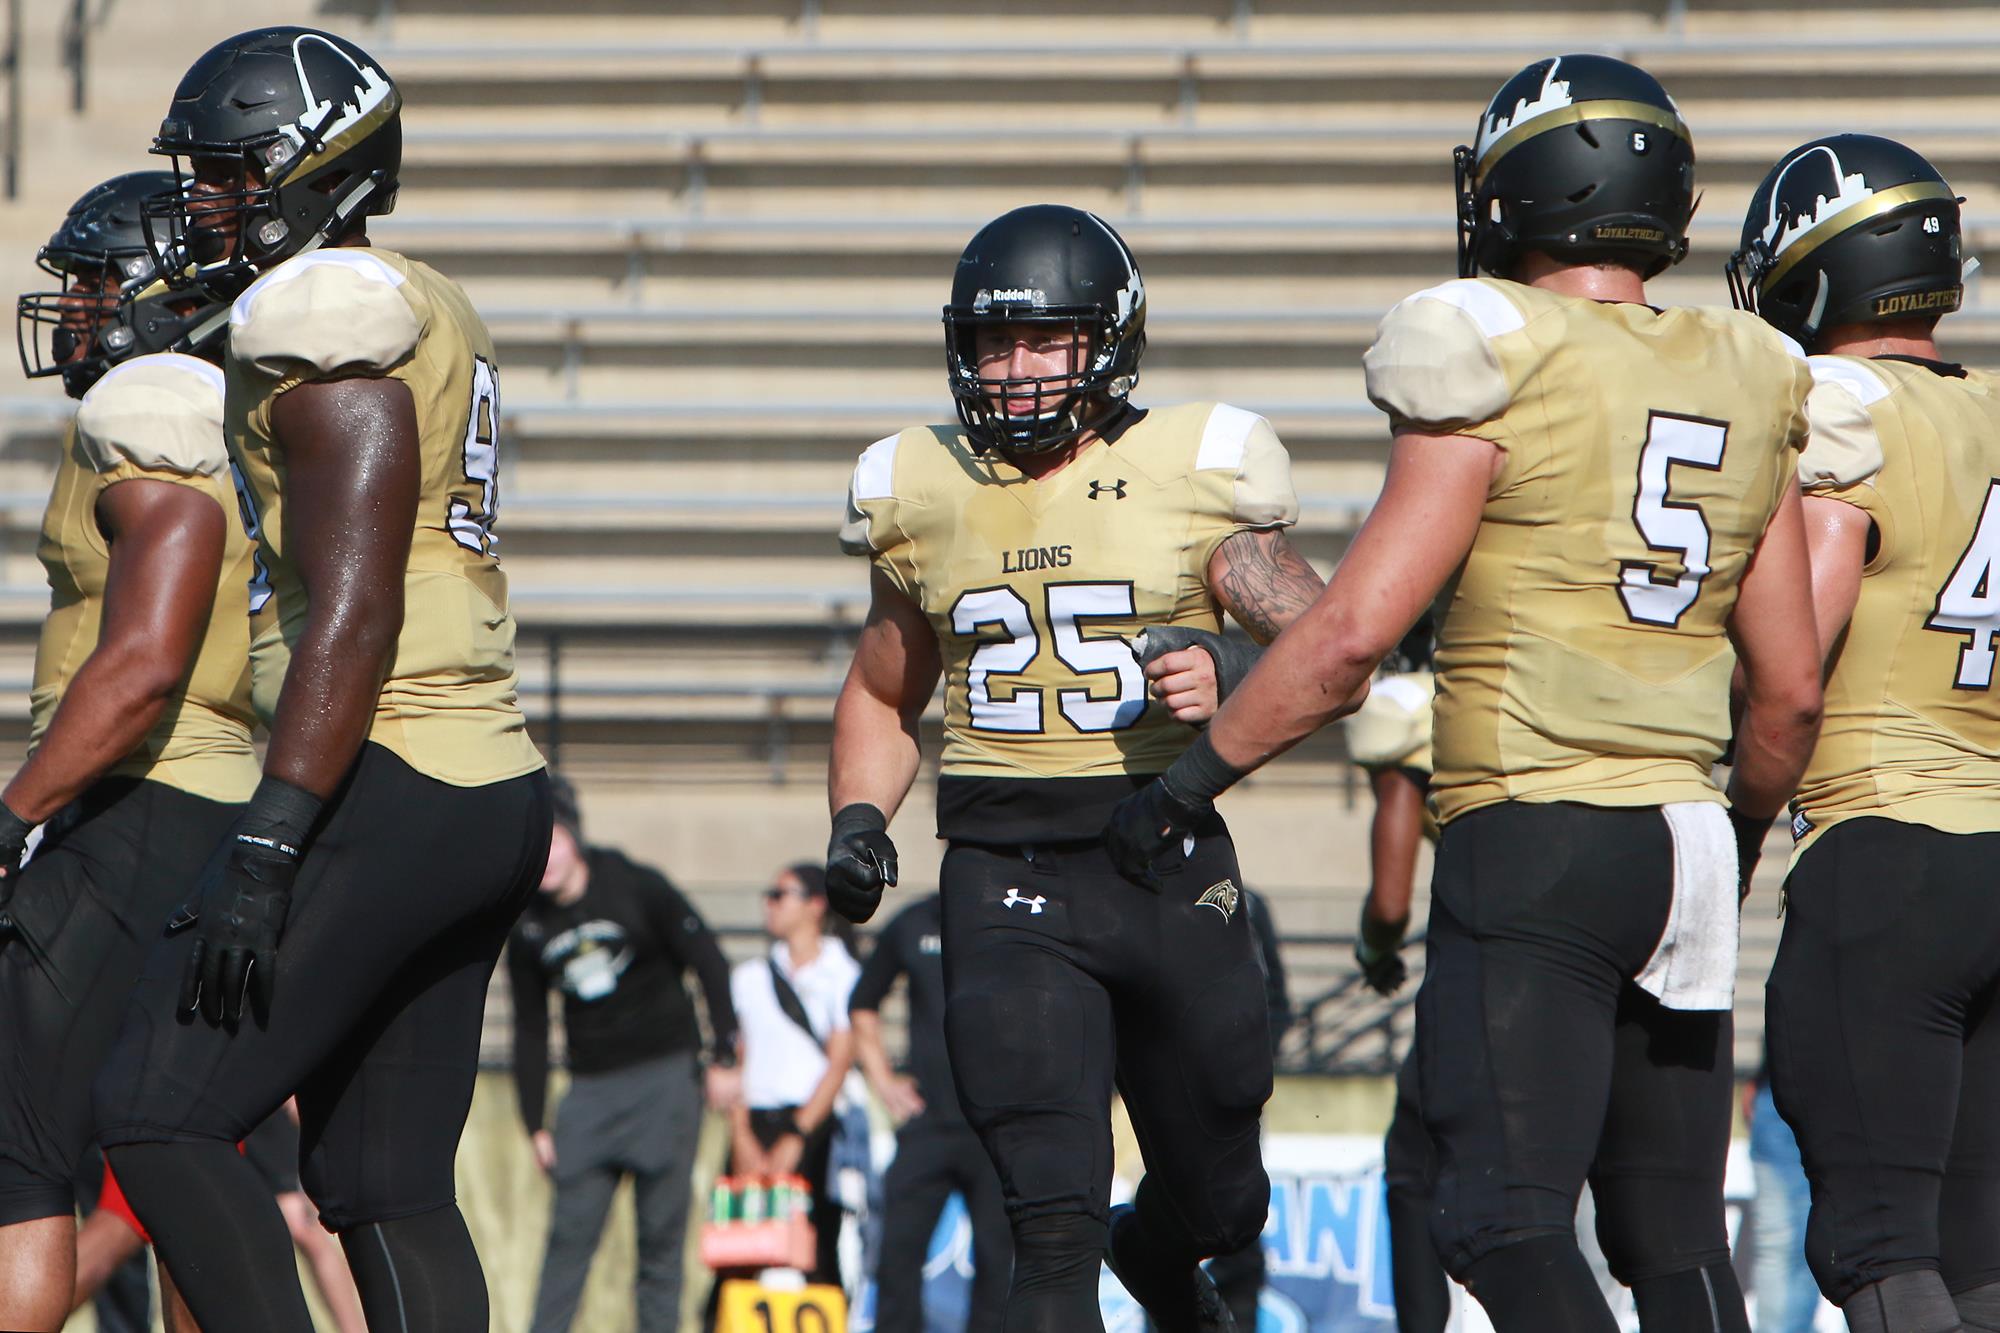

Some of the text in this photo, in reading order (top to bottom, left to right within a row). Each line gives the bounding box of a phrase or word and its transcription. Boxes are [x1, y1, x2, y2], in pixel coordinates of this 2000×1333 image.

[1633, 132, 1646, 151] 5
[1922, 216, 1940, 234] 49
[992, 288, 1032, 301] Riddell
[1614, 408, 1731, 630] 5
[1001, 544, 1072, 574] LIONS
[1921, 477, 2000, 691] 4
[947, 579, 1149, 735] 25
